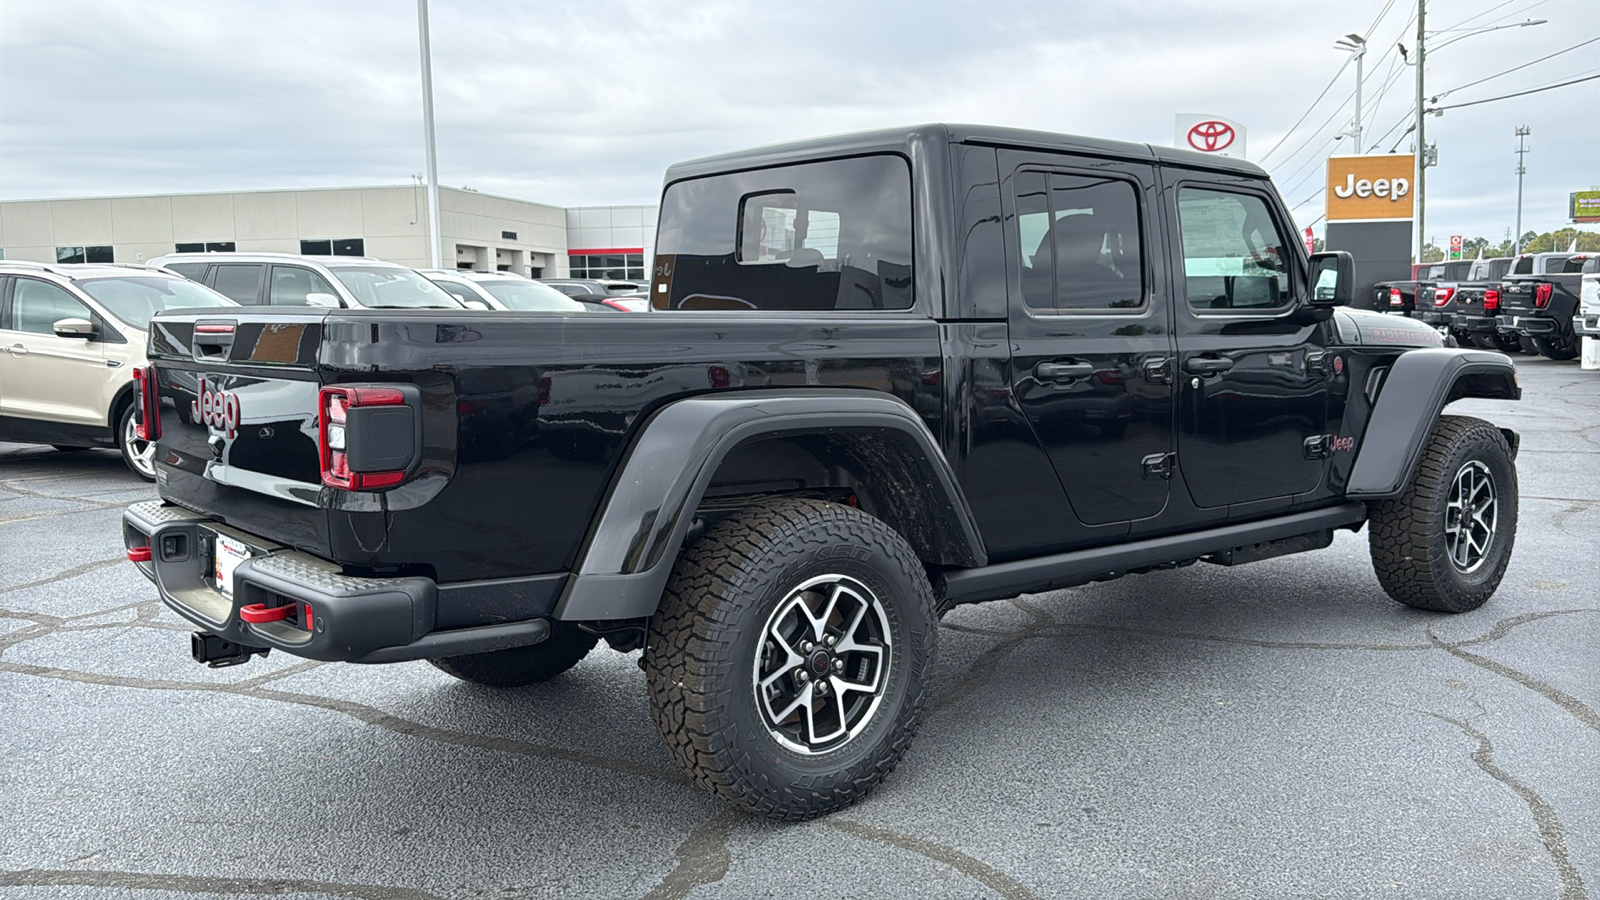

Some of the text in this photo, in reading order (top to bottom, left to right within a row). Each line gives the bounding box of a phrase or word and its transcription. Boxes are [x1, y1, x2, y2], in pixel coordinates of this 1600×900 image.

[1334, 173, 1409, 200] Jeep
[192, 377, 241, 439] Jeep
[1331, 435, 1354, 453] Jeep
[753, 541, 873, 617] FALKEN
